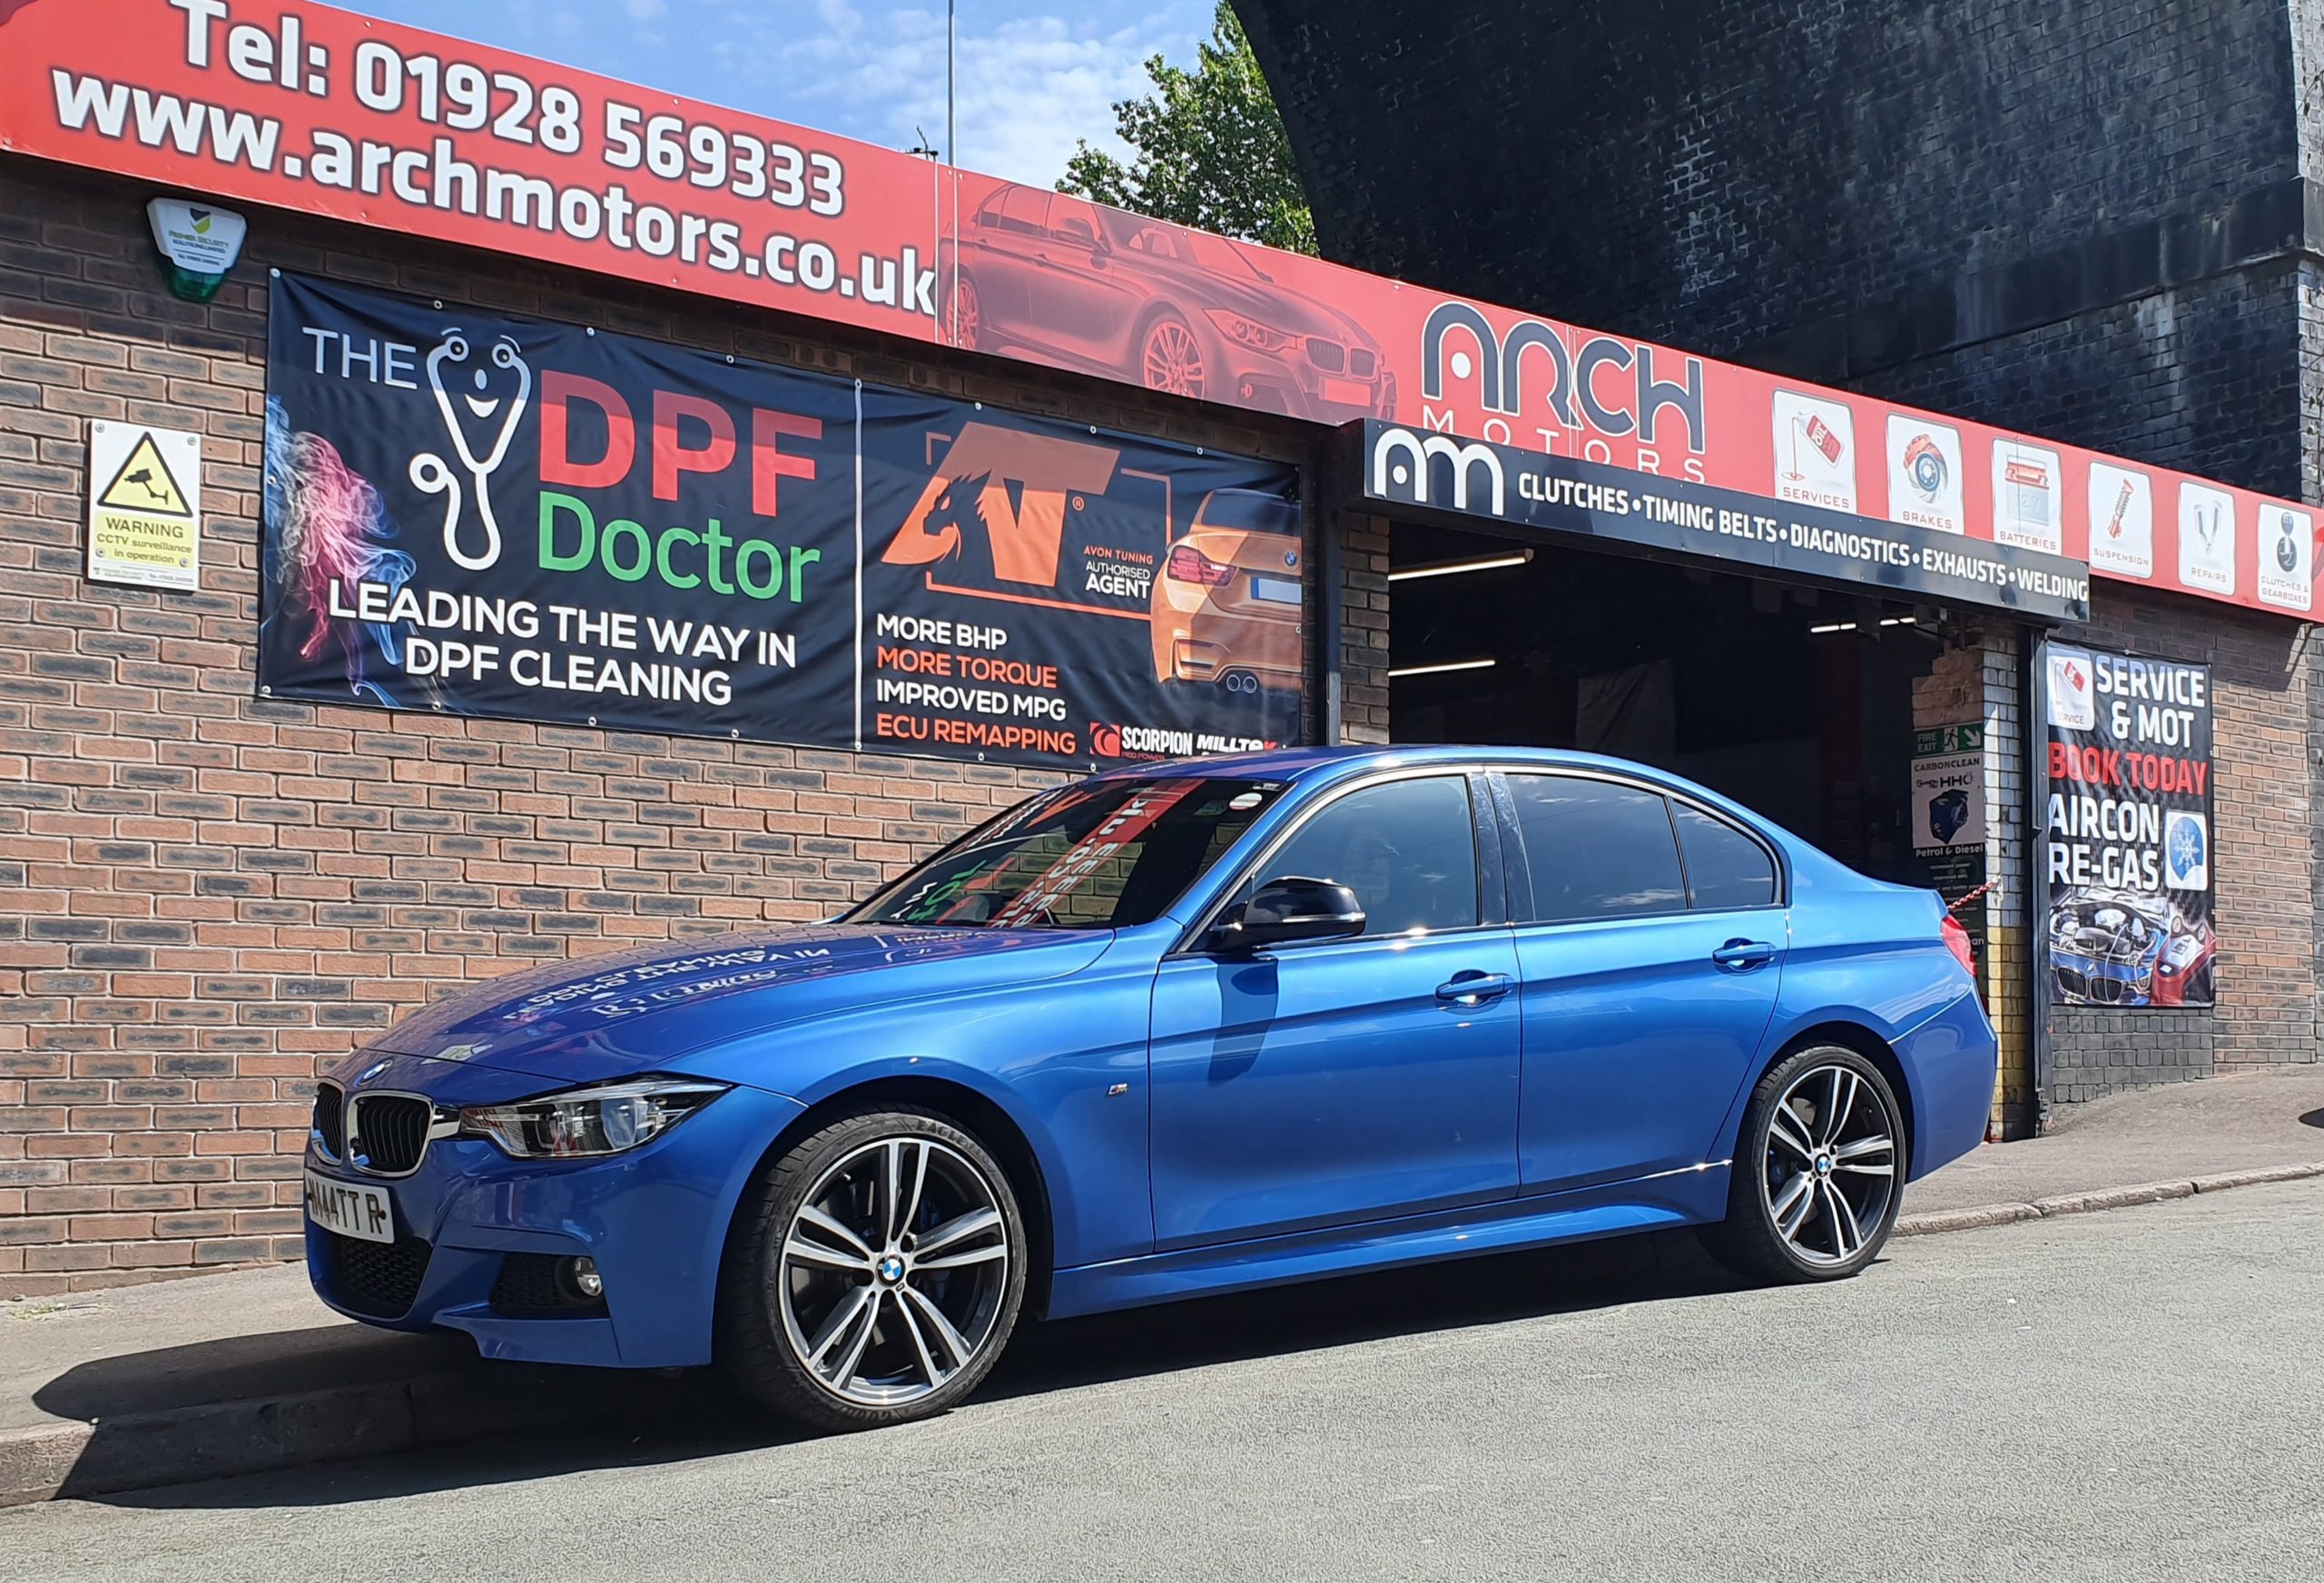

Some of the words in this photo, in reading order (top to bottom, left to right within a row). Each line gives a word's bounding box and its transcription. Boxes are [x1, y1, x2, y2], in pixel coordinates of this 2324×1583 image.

[170, 0, 328, 97] Tel:
[354, 41, 581, 153] 01928
[603, 101, 843, 216] 569333
[51, 69, 936, 316] www.archmotors.co.uk
[302, 326, 418, 390] THE
[1421, 300, 1706, 455] ARCH
[540, 369, 823, 517] DPF
[1422, 405, 1707, 485] MOTORS
[1783, 486, 1850, 509] SERVICES
[105, 516, 184, 539] WARNING
[1518, 472, 1629, 516] CLUTCHES
[1642, 495, 1714, 532] TIMING
[1718, 509, 1777, 543] BELTS
[1790, 522, 1910, 567] DIAGNOSTICS
[1922, 547, 2006, 586] EXHAUSTS
[2016, 567, 2088, 602] WELDING
[1903, 510, 1953, 530] BRAKES
[96, 533, 130, 546] CCTV
[132, 539, 192, 554] surveillance
[113, 548, 124, 557] in
[126, 551, 175, 564] operation
[538, 490, 822, 604] Doctor
[1083, 545, 1112, 558] AVON
[1116, 549, 1153, 565] TUNING
[2000, 530, 2056, 550] BATTERIES
[2093, 547, 2150, 566] SUSPENSION
[1085, 573, 1150, 599] AGENT
[1086, 560, 1150, 579] AUTHORISED
[2191, 566, 2227, 584] REPAIRS
[2260, 575, 2301, 592] CLUTCHES
[2261, 586, 2308, 605] GEARBOXES
[329, 578, 539, 639] LEADING
[548, 605, 637, 651] THE
[646, 616, 751, 663] WAY
[757, 631, 797, 668] IN
[877, 613, 951, 644] MORE
[957, 624, 1008, 651] BHP
[406, 637, 498, 682] DPF
[510, 650, 733, 706] CLEANING
[877, 645, 951, 676] MORE
[956, 654, 1058, 689] TORQUE
[2095, 654, 2206, 709] SERVICE
[877, 678, 1009, 715] IMPROVED
[1013, 693, 1067, 722] MPG
[876, 713, 928, 742] ECU
[934, 720, 1076, 755] REMAPPING
[1121, 725, 1193, 756] SCORPION
[1917, 732, 1937, 742] FIRE
[2111, 701, 2132, 741] &
[2137, 703, 2194, 749] MOT
[1917, 742, 1937, 752] EXIT
[2048, 741, 2123, 788] BOOK
[2125, 751, 2207, 796] TODAY
[2047, 792, 2160, 845] AIRCON
[1915, 847, 1943, 858] Petrol
[1955, 843, 1984, 854] Diesel
[2048, 841, 2159, 892] RE-GAS
[916, 1118, 969, 1146] EAGLE
